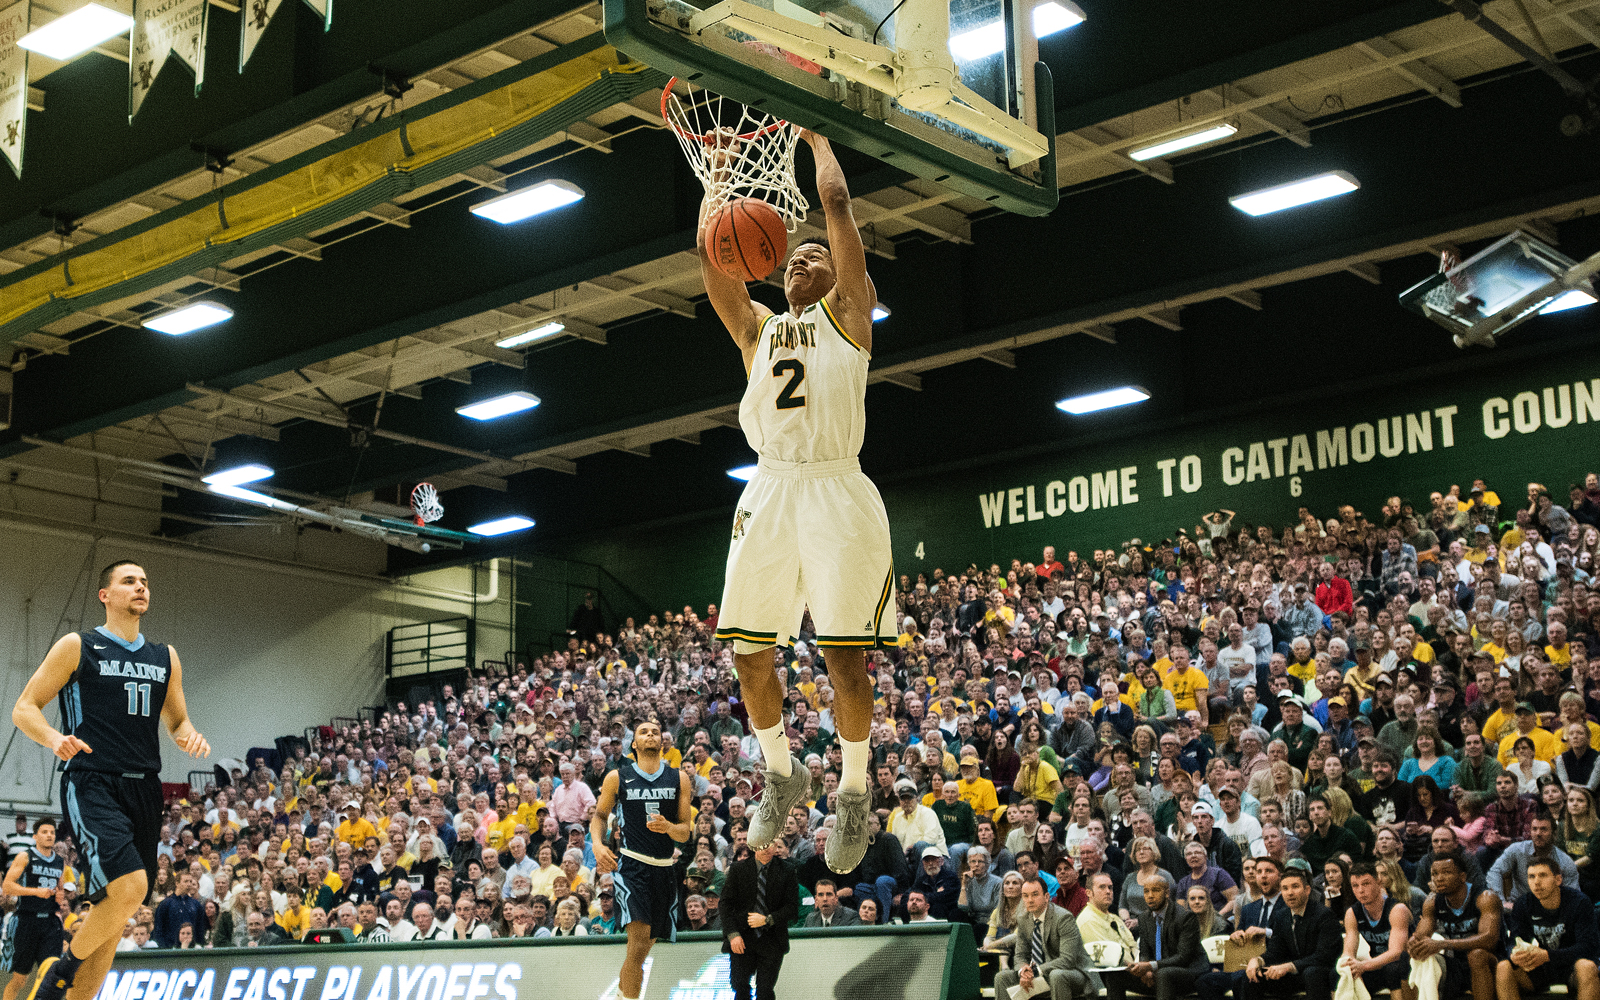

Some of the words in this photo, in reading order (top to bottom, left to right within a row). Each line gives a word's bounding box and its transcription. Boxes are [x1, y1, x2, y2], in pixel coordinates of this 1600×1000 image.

[772, 358, 806, 411] 2
[979, 465, 1139, 529] WELCOME
[1157, 454, 1202, 497] TO
[1221, 405, 1458, 486] CATAMOUNT
[1290, 476, 1302, 498] 6
[915, 541, 925, 560] 4
[98, 660, 166, 683] MAINE
[124, 681, 151, 717] 11
[626, 787, 676, 801] MAINE
[644, 801, 660, 823] 5
[943, 814, 958, 823] UVM
[92, 968, 216, 1000] MERICA
[222, 966, 318, 1000] EAST
[320, 962, 523, 1000] PLAYOFFS
